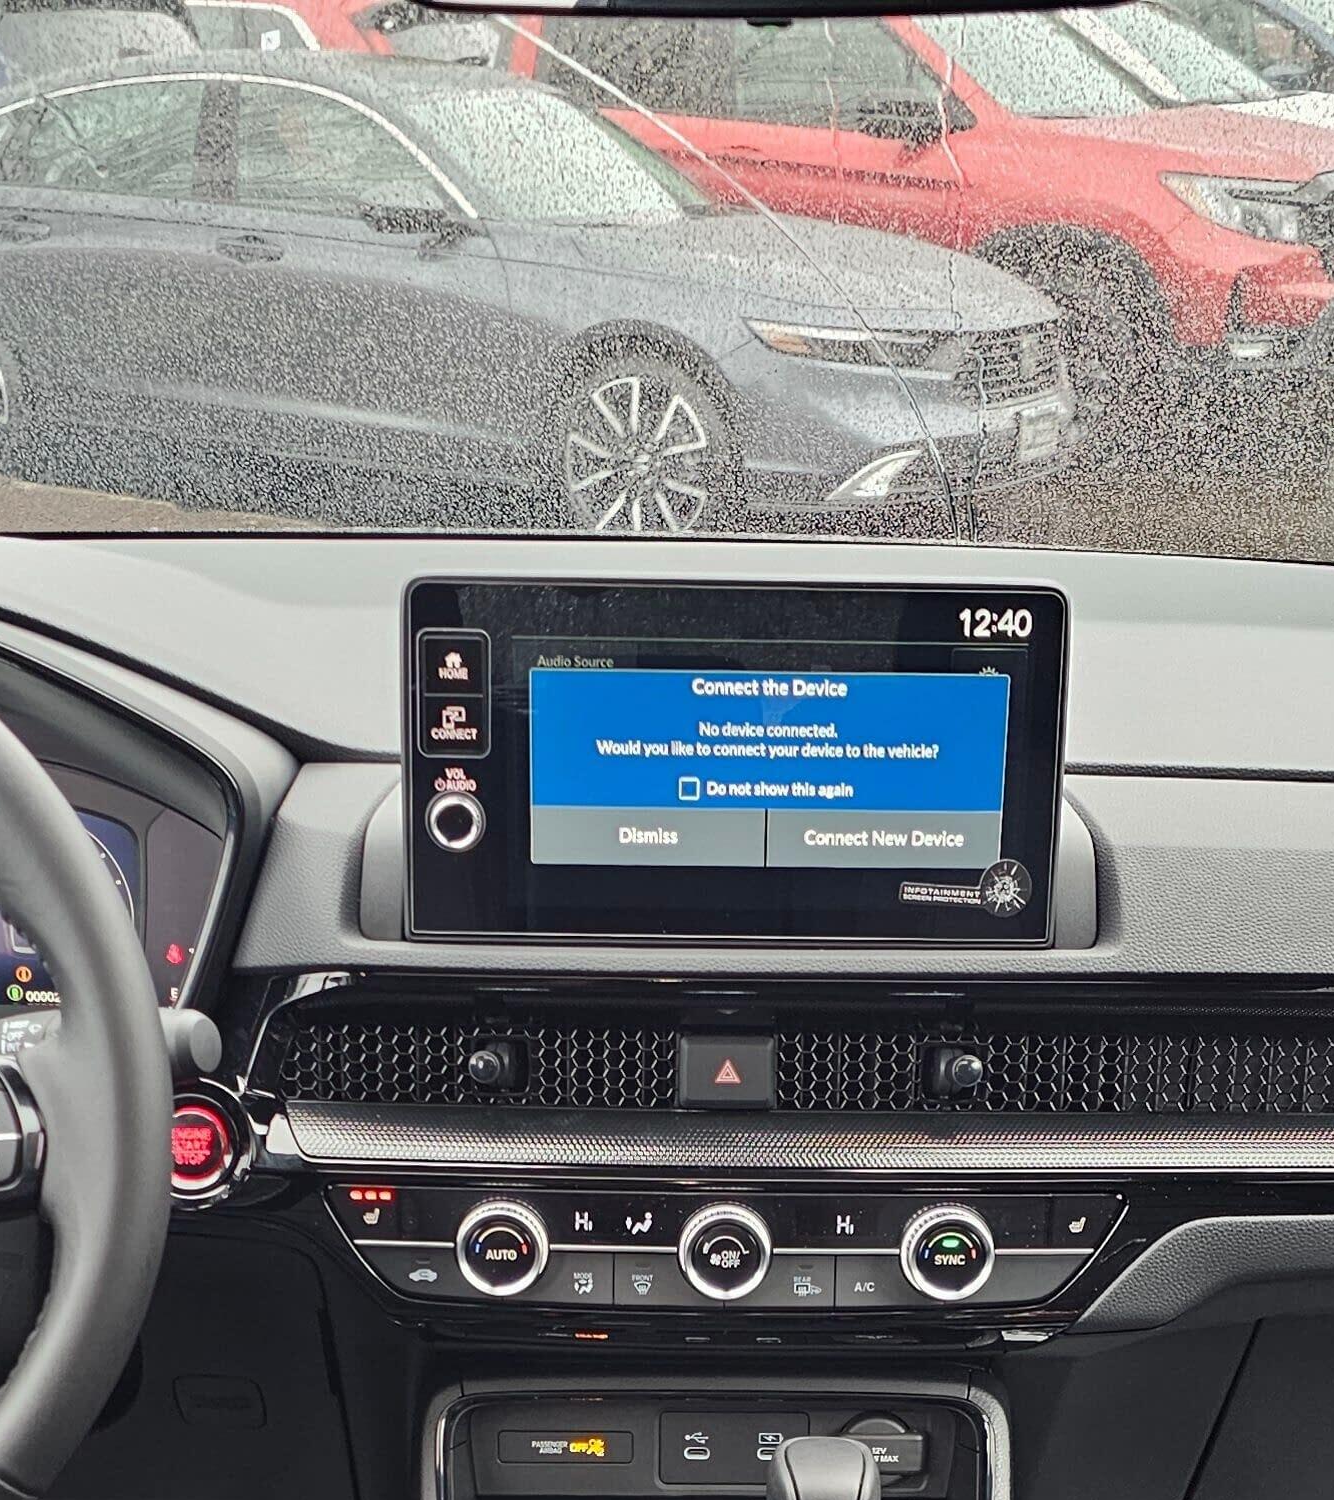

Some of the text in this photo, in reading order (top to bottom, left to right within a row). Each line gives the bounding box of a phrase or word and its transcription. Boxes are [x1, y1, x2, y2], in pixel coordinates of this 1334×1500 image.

[958, 609, 1033, 637] 12:40
[537, 655, 614, 668] Audio Source
[438, 667, 468, 680] HOME
[691, 678, 848, 697] Connect the Device
[431, 728, 478, 740] CONNECT
[699, 721, 838, 738] No device connected.
[595, 739, 939, 759] Would you like to connect your device to the vehicle?
[445, 768, 466, 780] VOL
[447, 778, 476, 791] AUDIO
[706, 780, 854, 799] Do not show this again
[619, 827, 678, 845] Dismiss
[803, 829, 964, 848] Connect New Device
[903, 886, 981, 898] INFOTAINMENT
[170, 987, 179, 1000] E
[485, 1250, 517, 1260] AUTO
[721, 1249, 740, 1260] ON/
[934, 1254, 966, 1266] SYNC
[721, 1258, 740, 1269] OFF
[854, 1282, 875, 1293] A/C
